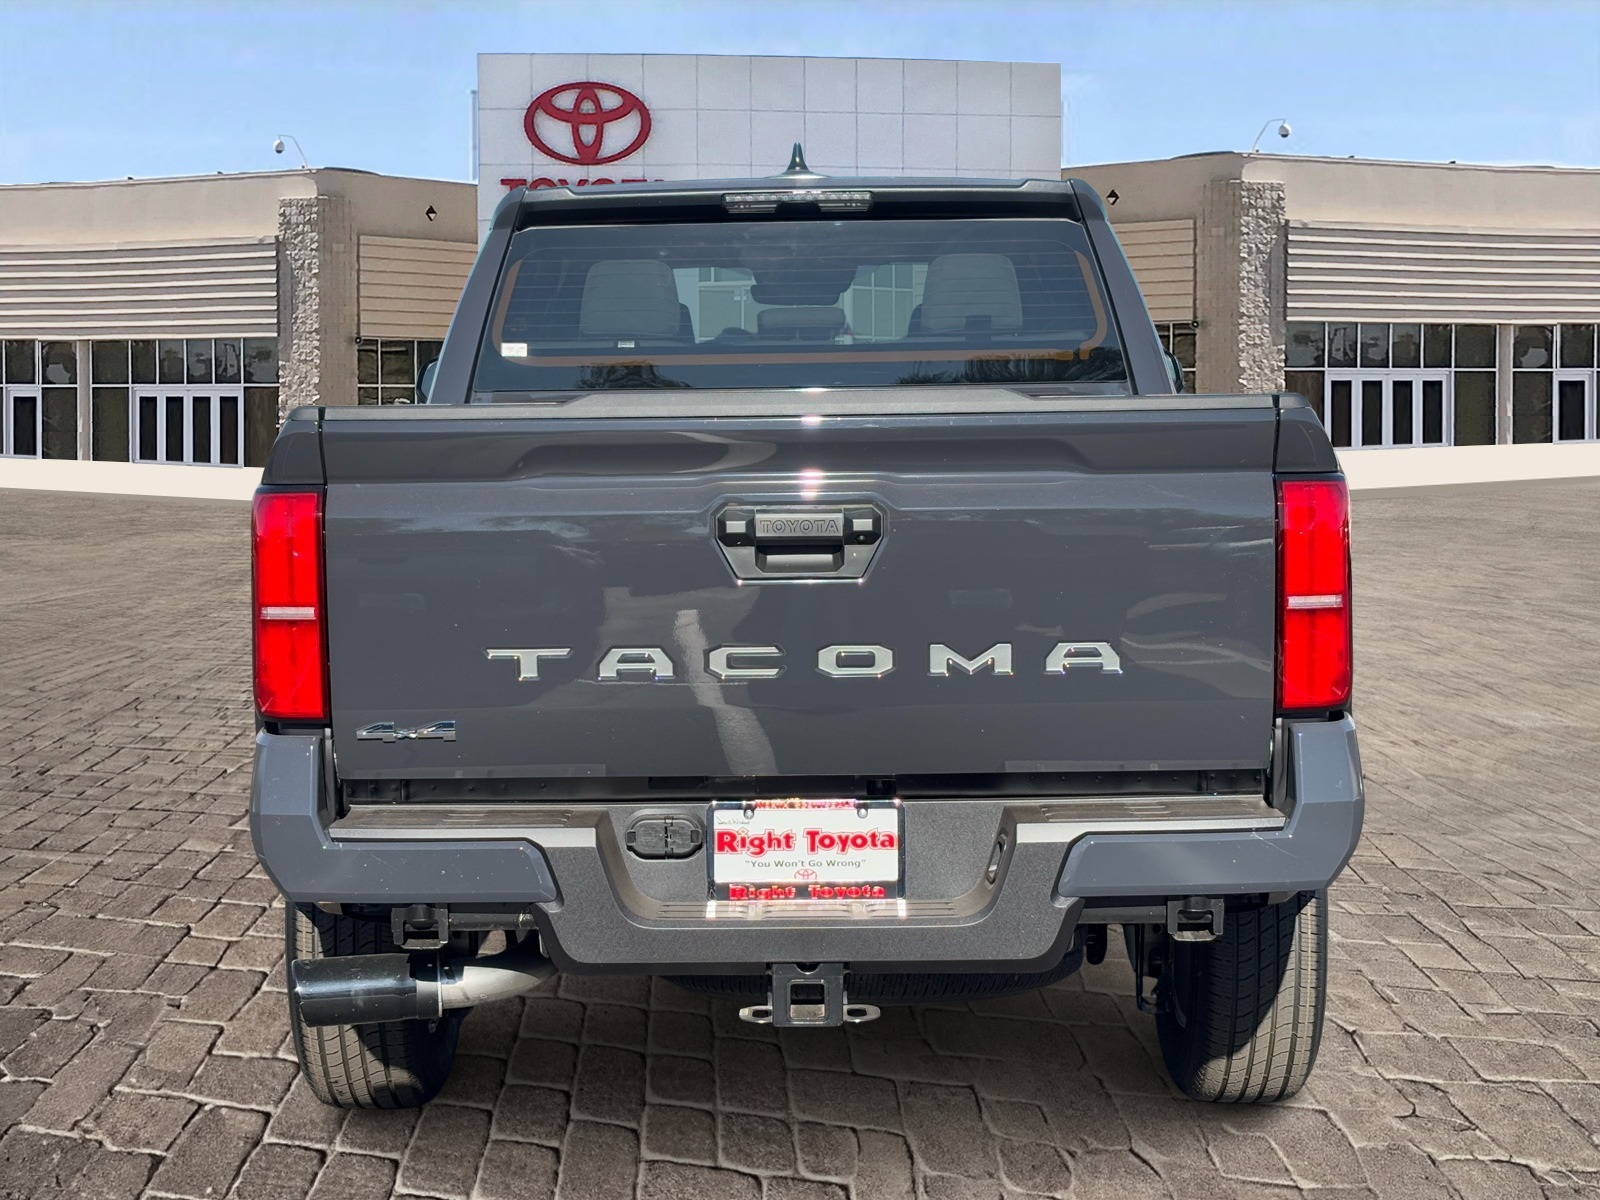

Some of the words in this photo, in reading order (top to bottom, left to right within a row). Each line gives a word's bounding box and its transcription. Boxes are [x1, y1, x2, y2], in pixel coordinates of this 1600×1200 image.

[759, 519, 839, 534] TOYOTA
[483, 642, 1123, 679] TACOMA
[715, 828, 796, 858] Right
[803, 828, 898, 855] Toyota
[774, 859, 805, 868] Won't
[808, 859, 822, 868] Go
[728, 883, 796, 900] Right
[807, 884, 886, 900] Toyota
